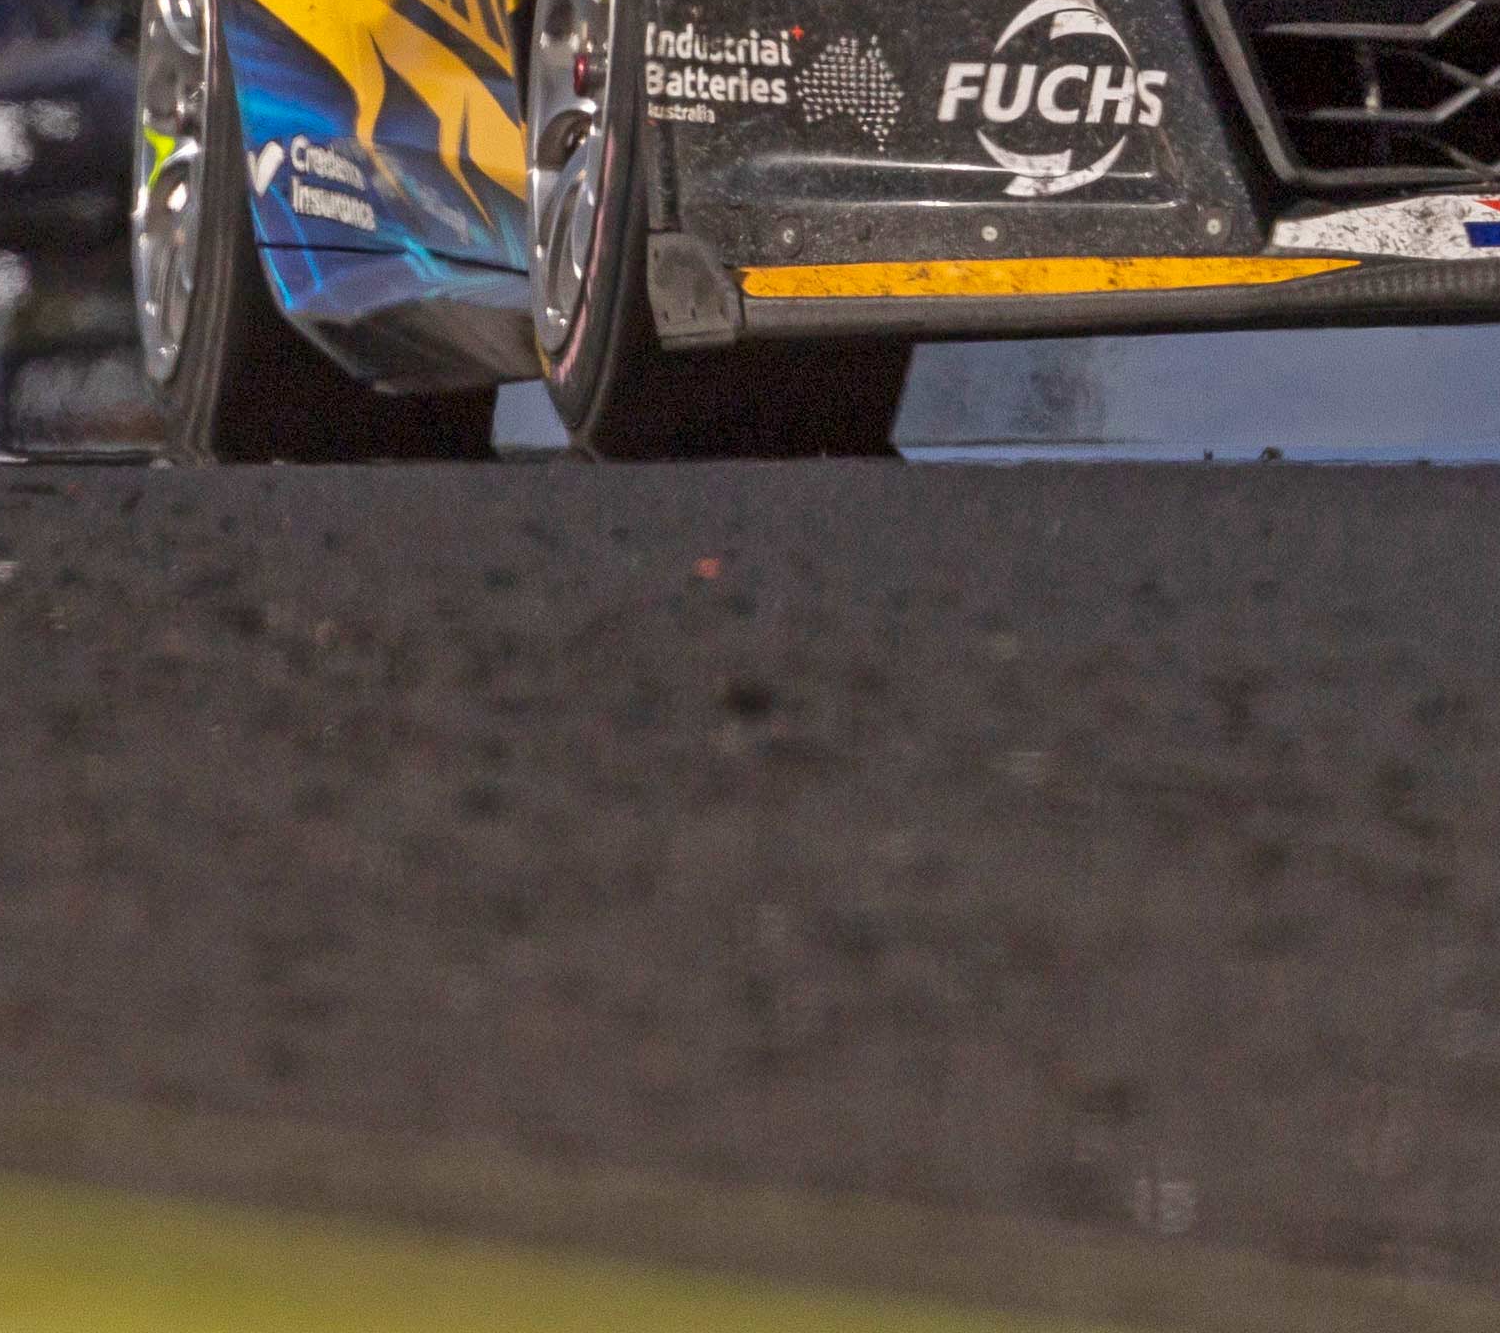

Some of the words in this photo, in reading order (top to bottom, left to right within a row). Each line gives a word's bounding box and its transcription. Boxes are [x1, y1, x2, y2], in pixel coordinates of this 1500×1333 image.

[644, 21, 792, 68] Industrial
[644, 60, 789, 105] Batteries
[936, 61, 1168, 129] FUCHS
